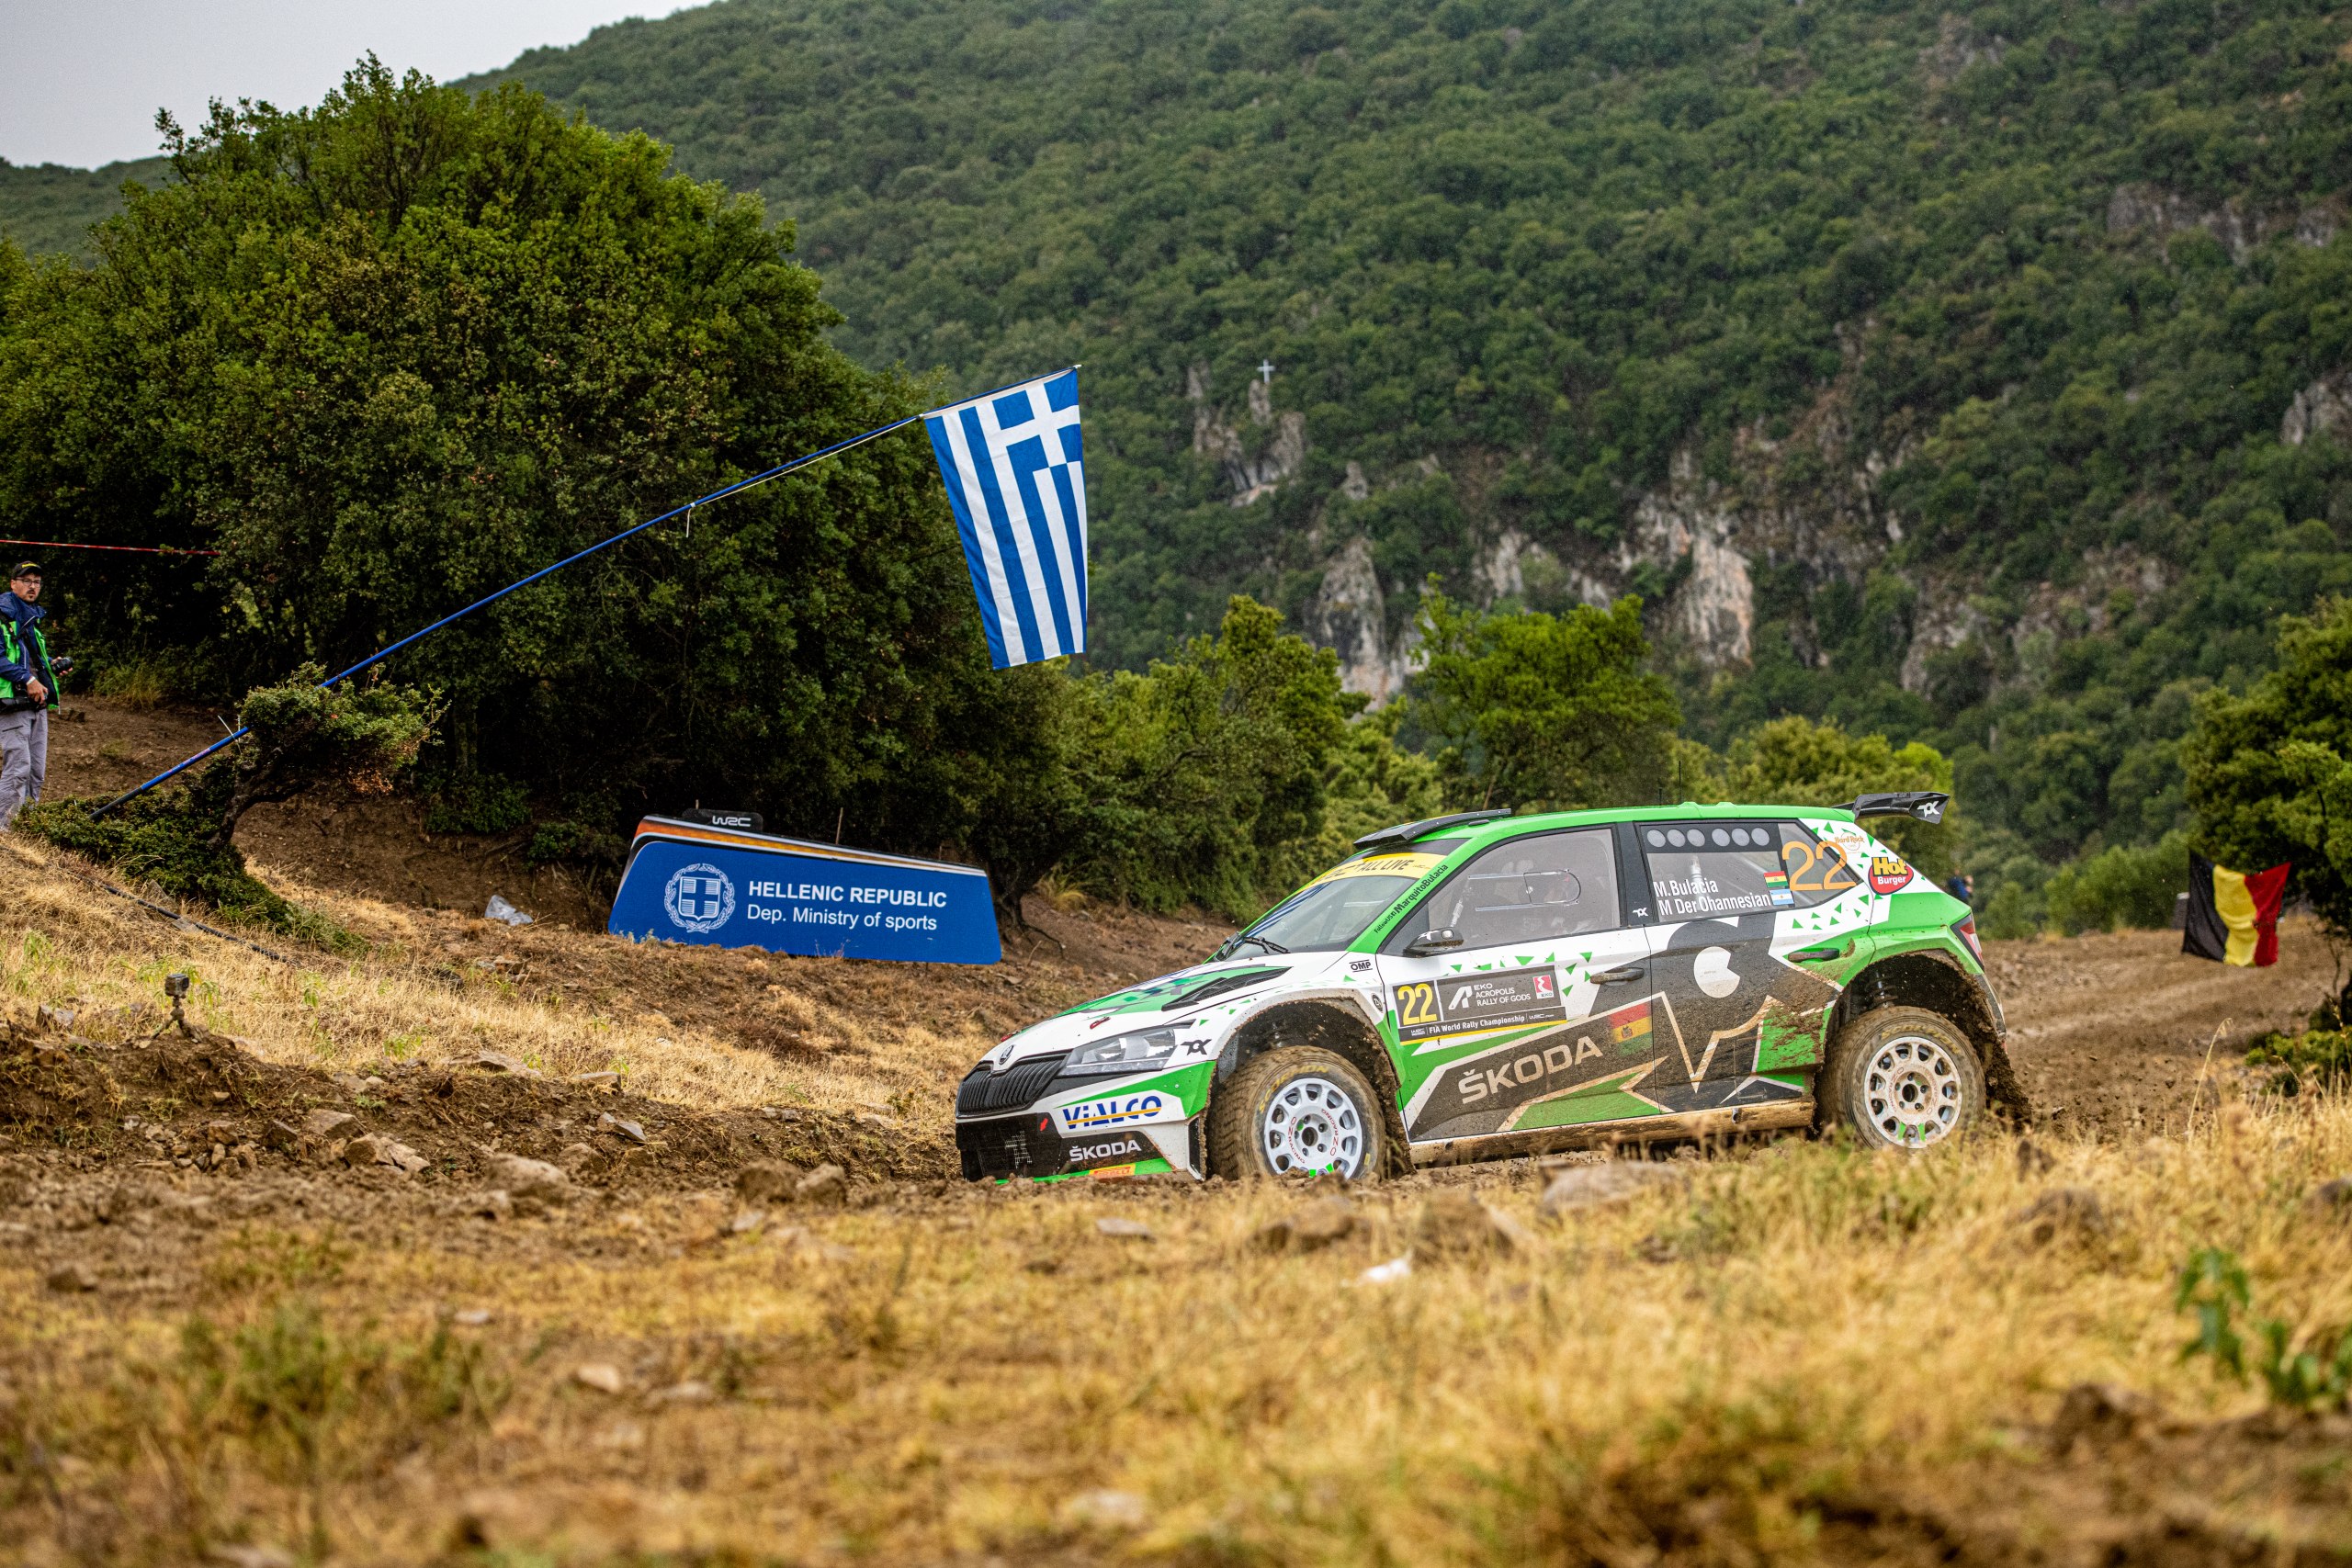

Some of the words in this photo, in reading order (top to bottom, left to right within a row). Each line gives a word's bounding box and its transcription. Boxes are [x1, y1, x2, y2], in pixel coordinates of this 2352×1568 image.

[712, 816, 752, 827] WRC
[1383, 859, 1415, 871] LIVE
[1781, 840, 1857, 891] 22
[1871, 856, 1908, 876] Hot
[1877, 876, 1906, 885] Burger
[749, 881, 844, 902] HELLENIC
[850, 887, 947, 908] REPUBLIC
[1674, 898, 1697, 915] Der
[1699, 892, 1771, 912] Ohannesian
[747, 904, 786, 924] Dep.
[793, 907, 859, 930] Ministry
[864, 912, 882, 928] of
[885, 916, 937, 932] sports
[1351, 961, 1372, 971] OMP
[1474, 983, 1493, 991] EKO
[1476, 987, 1515, 998] ACROPOLIS
[1397, 983, 1437, 1025] 22
[1476, 997, 1498, 1007] RALLY
[1499, 996, 1510, 1004] OF
[1510, 993, 1532, 1002] GODS
[1429, 1025, 1441, 1034] FIA
[1441, 1021, 1461, 1032] World
[1462, 1021, 1478, 1031] Rally
[1479, 1015, 1525, 1028] Championship
[1458, 1035, 1604, 1104] ŠKODA
[1069, 1139, 1141, 1162] ŠKODA
